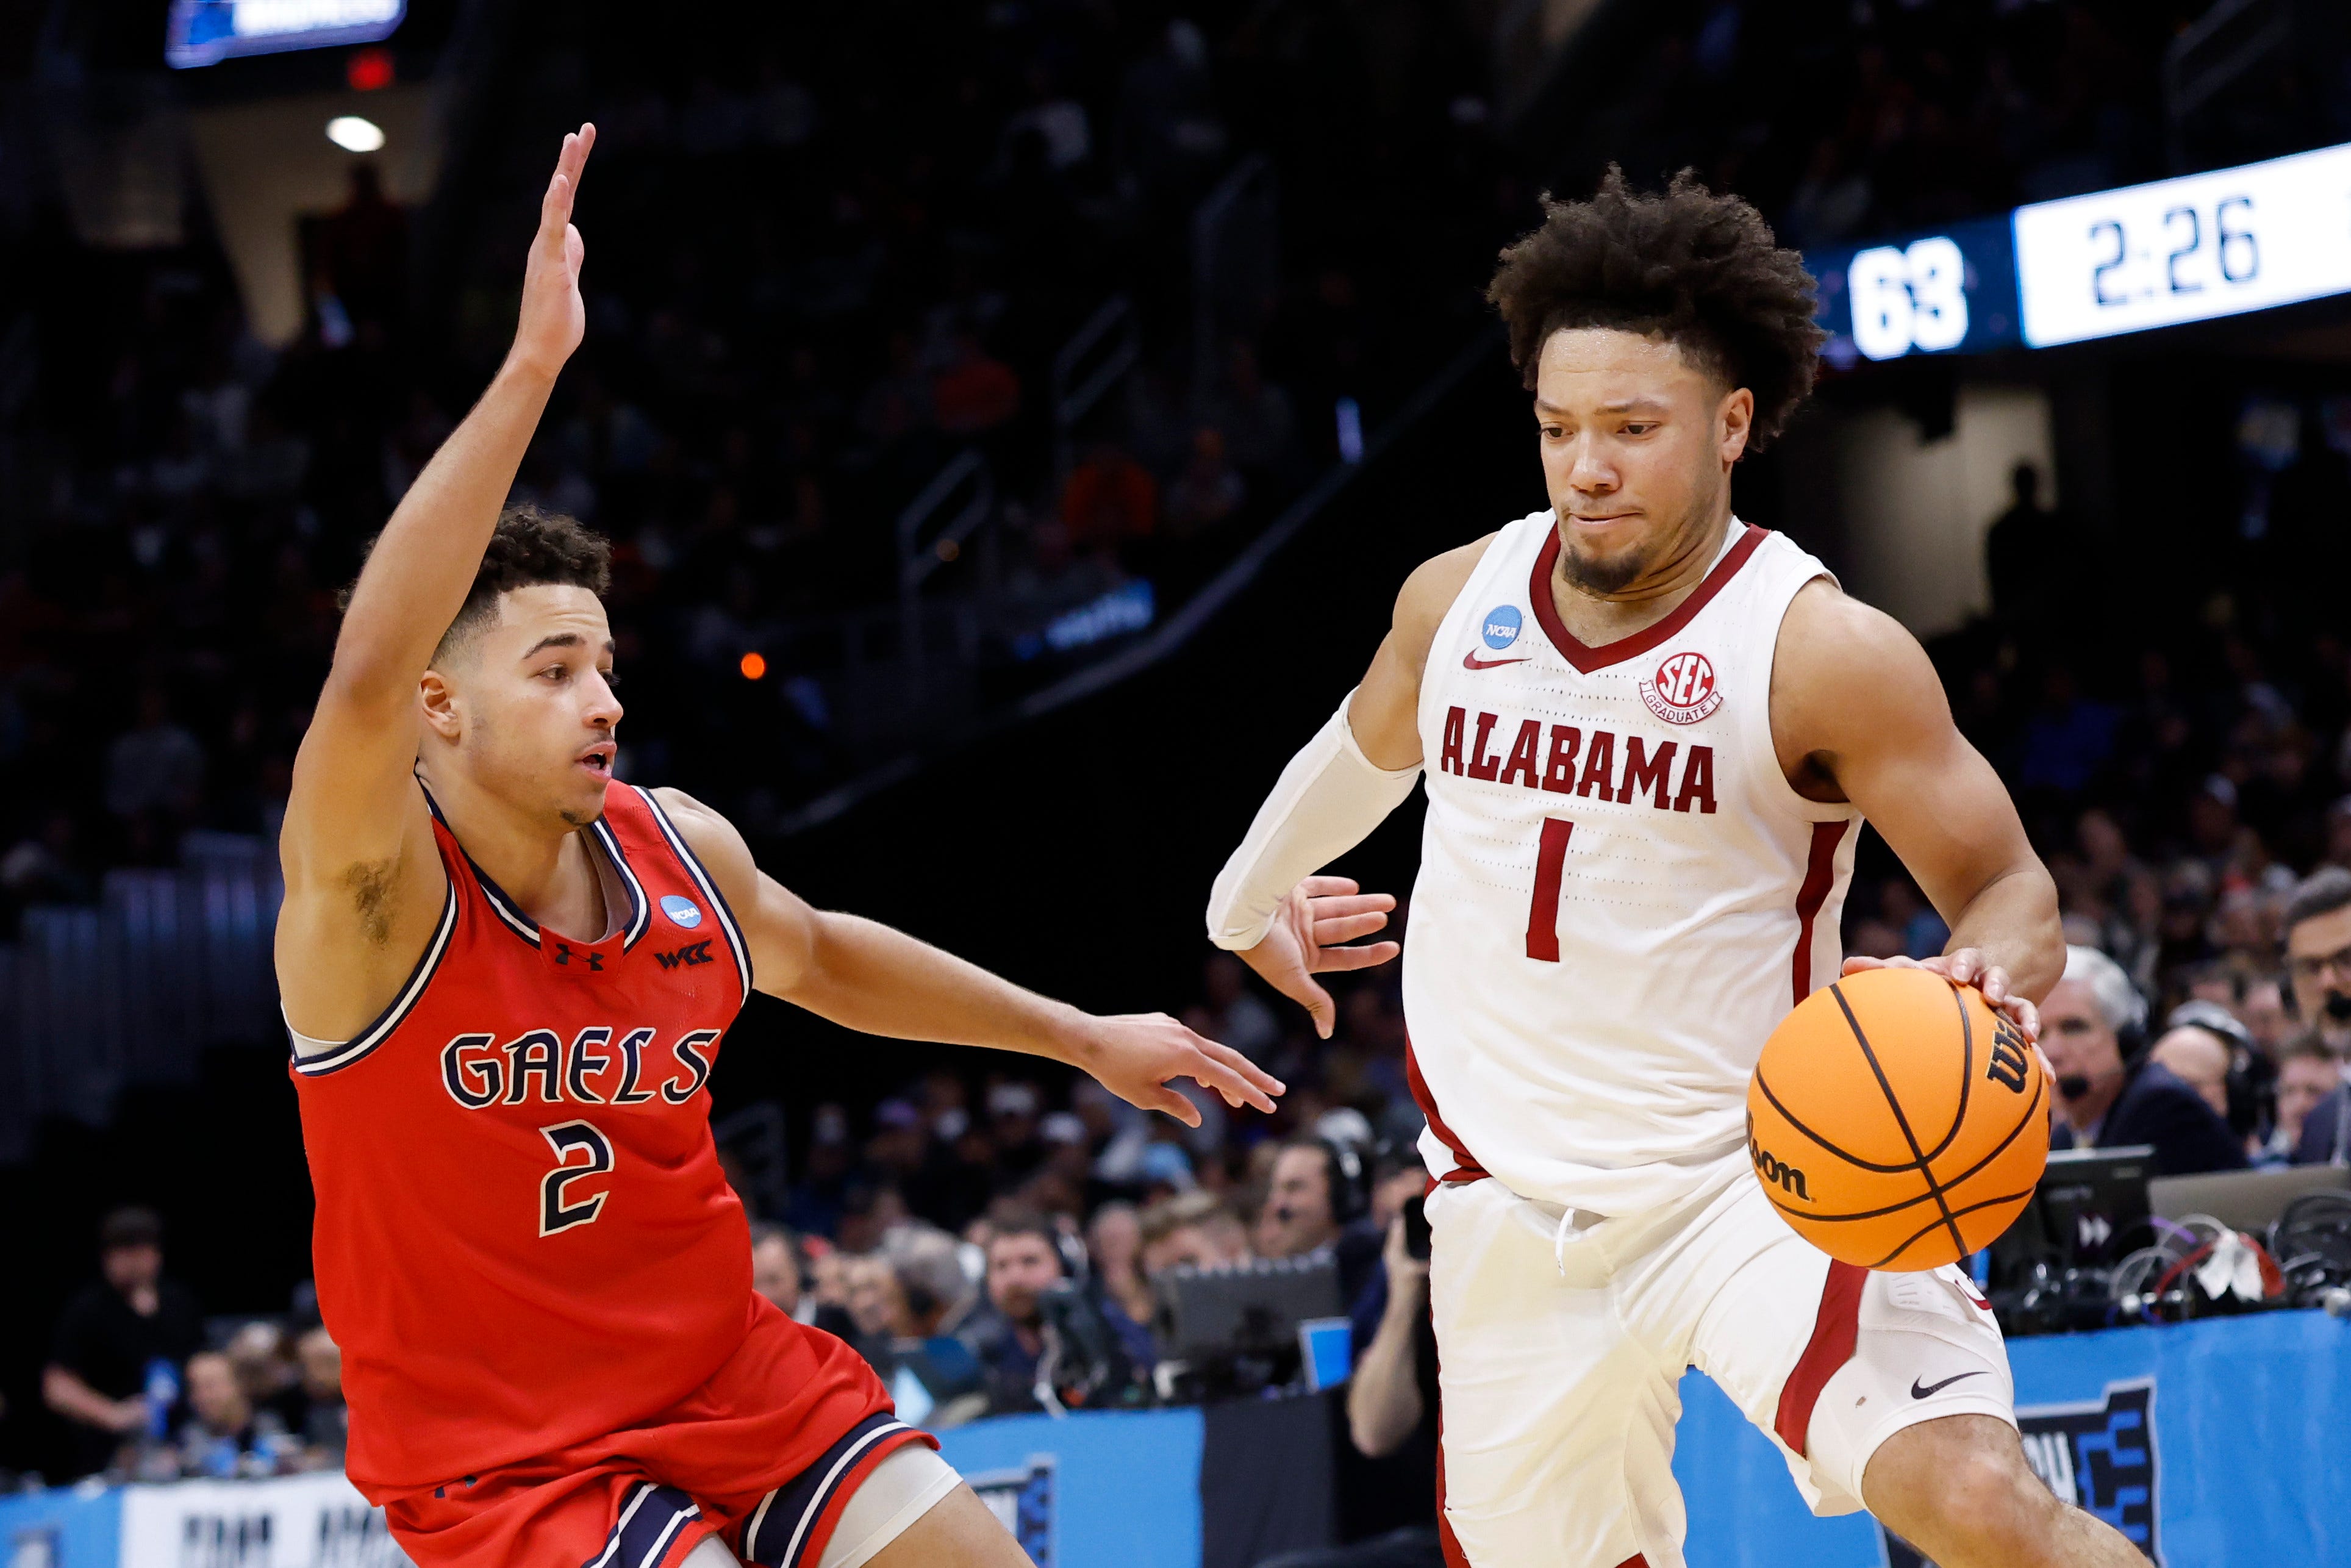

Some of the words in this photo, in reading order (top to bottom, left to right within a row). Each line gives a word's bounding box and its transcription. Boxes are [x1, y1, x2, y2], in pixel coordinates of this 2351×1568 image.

[2088, 196, 2259, 306] 2:26
[1848, 235, 1969, 361] 63
[1486, 624, 1517, 639] NCAA
[1646, 695, 1709, 723] GRADUATE
[1659, 654, 1712, 705] SEC
[1441, 706, 1717, 814] ALABAMA
[670, 907, 700, 920] NCAA
[1526, 817, 1574, 963] 1
[653, 939, 714, 970] WCC
[440, 1026, 721, 1110] GAELS
[539, 1119, 615, 1238] 2
